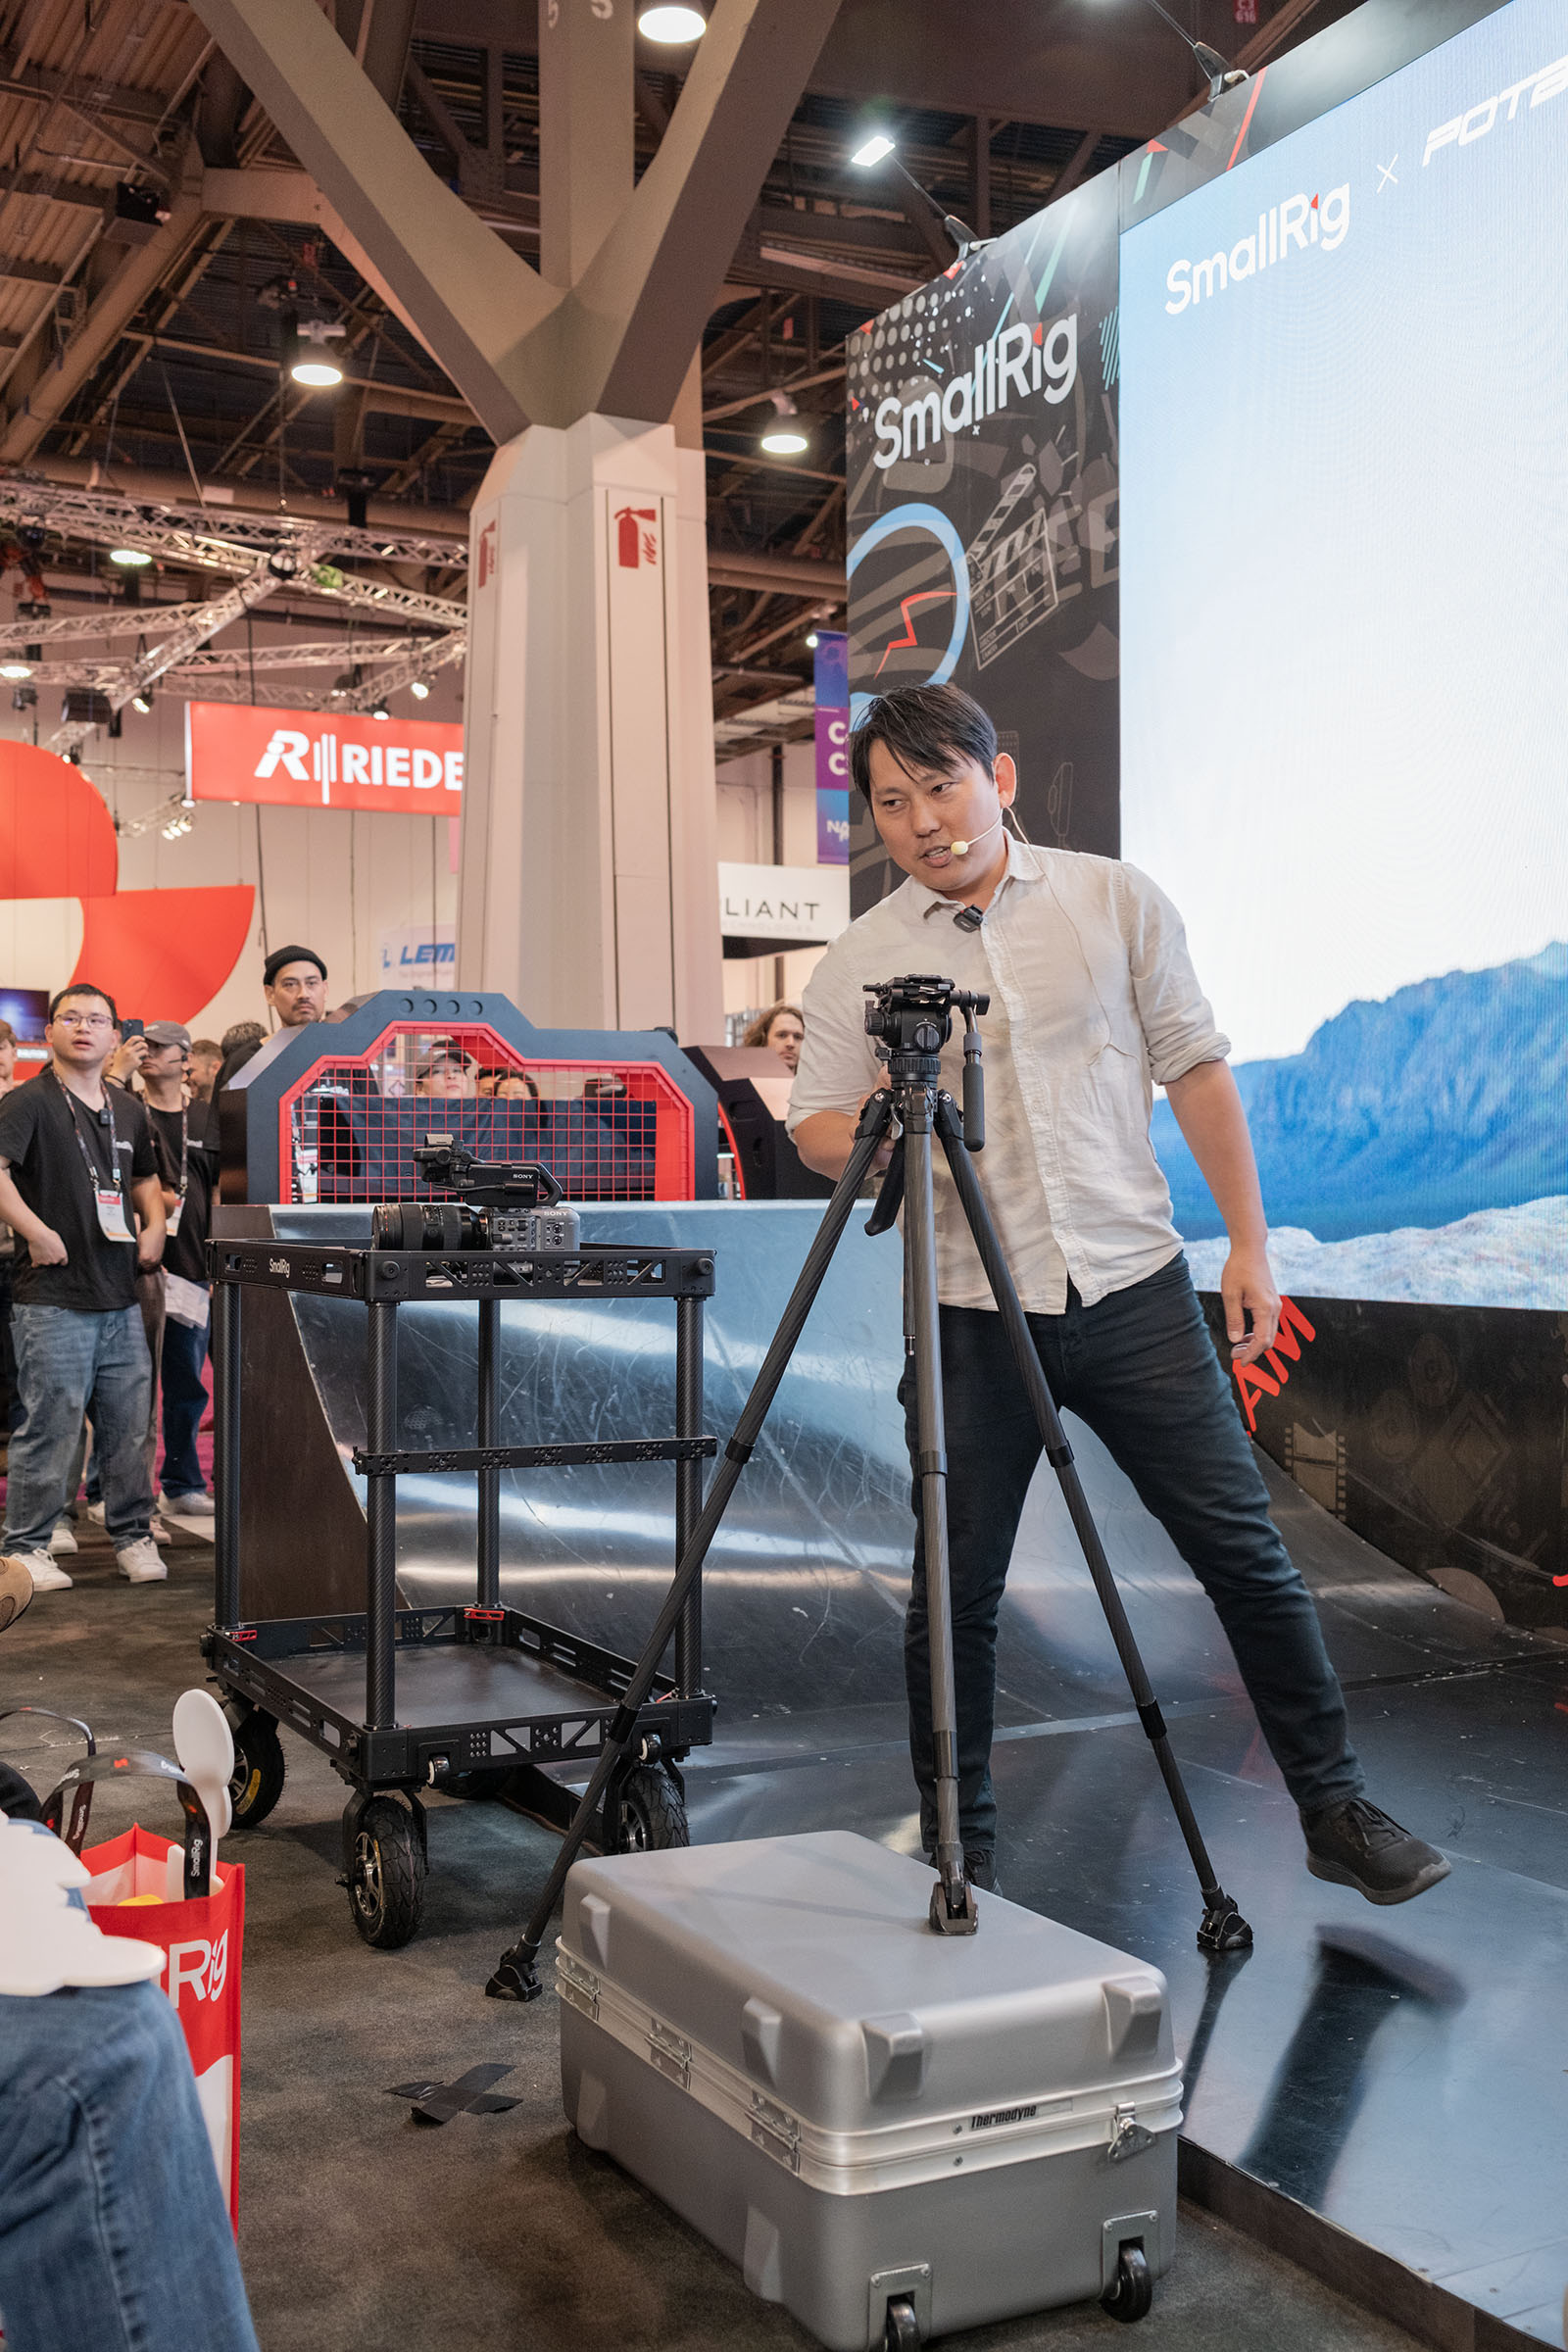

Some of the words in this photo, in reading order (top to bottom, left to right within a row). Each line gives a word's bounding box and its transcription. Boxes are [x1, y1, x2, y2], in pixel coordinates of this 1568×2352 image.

[1165, 182, 1350, 315] SmallRig
[873, 313, 1078, 469] SmallRig
[342, 743, 464, 791] RIEDE
[726, 897, 819, 920] LIANT
[191, 1838, 203, 1878] SmallRig
[160, 1928, 228, 2009] Rig
[971, 2104, 1037, 2129] Thermodyne
